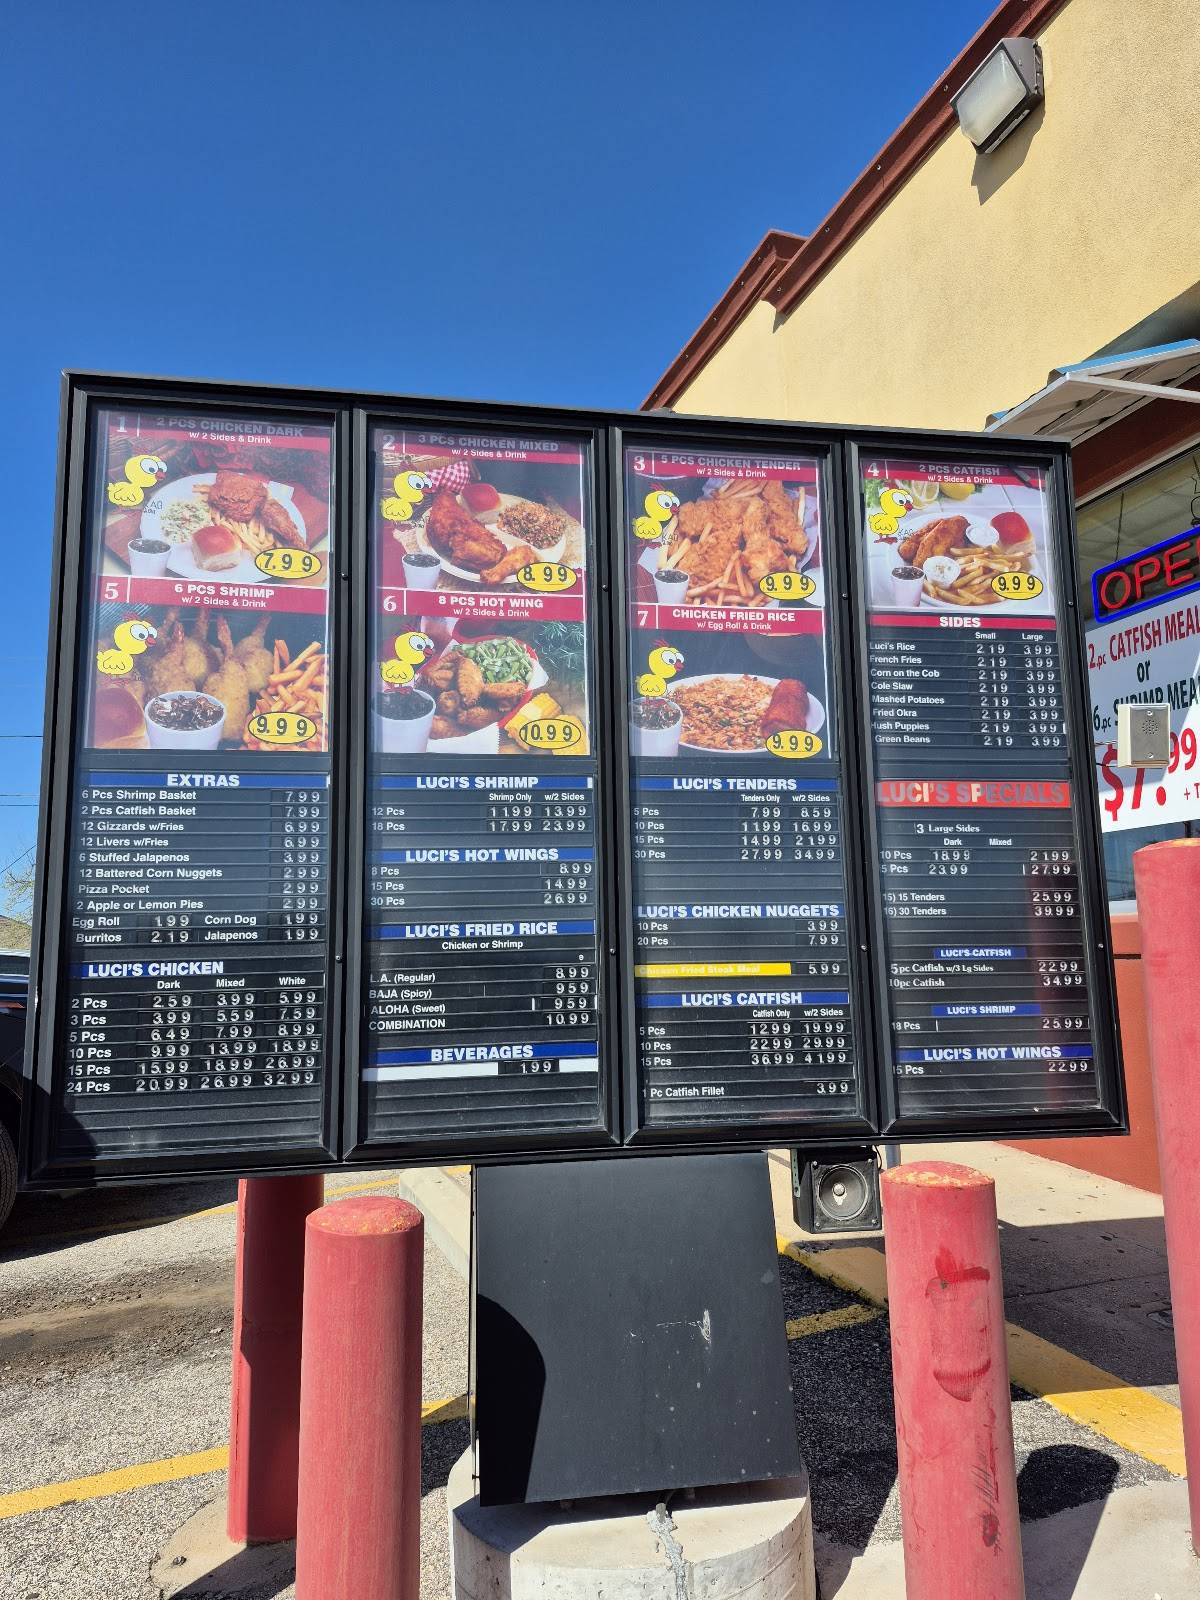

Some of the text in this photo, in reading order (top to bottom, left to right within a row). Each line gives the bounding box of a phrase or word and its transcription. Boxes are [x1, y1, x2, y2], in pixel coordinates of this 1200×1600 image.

[115, 416, 127, 433] 1
[156, 417, 304, 436] 2 PCS CHICKEN DARK
[382, 435, 396, 450] 2
[418, 435, 559, 451] 3 PCS CHICKEN MIXED
[634, 456, 645, 471] 3
[661, 456, 801, 470] 5 PCS CHICKEN TENDER
[868, 463, 880, 476] 4
[929, 465, 951, 474] PCS
[953, 466, 1000, 475] CATFISH
[1101, 536, 1200, 609] OPE
[104, 582, 119, 600] 5
[174, 584, 274, 598] 6 PCS SHRIMP
[203, 597, 229, 606] Sides
[232, 598, 239, 606] &
[242, 600, 267, 608] Drink
[383, 596, 397, 611] 6
[439, 596, 544, 608] 8 PCS HOT WING
[637, 611, 649, 626] 7
[673, 609, 795, 621] CHICKEN FRIED RICE
[708, 622, 723, 630] Egg
[940, 617, 981, 628] SIDES
[1022, 633, 1043, 641] Large
[1110, 619, 1161, 661] CATFISH
[896, 643, 915, 651] Rice
[871, 669, 891, 677] Corn
[922, 670, 940, 678] Cob
[1137, 660, 1150, 682] or
[872, 695, 945, 704] Mashed Potatoes
[1167, 676, 1200, 712] MEA
[896, 709, 917, 717] Okra
[875, 735, 901, 743] Green
[167, 774, 240, 787] EXTRAS
[416, 777, 539, 788] LUCI'S SHRIMP
[673, 778, 797, 790] LUCI'S TENDERS
[81, 790, 196, 802] 6 Pcs Shrimp Basket
[489, 793, 514, 802] Shrimp
[516, 794, 532, 802] Only
[544, 793, 559, 801] w/2
[956, 783, 1064, 803] SPECIALS
[81, 821, 184, 831] 12 Gizzards w/Fries
[916, 824, 980, 833] 3 Large Sides
[944, 838, 1012, 846] Dark Mixed
[405, 849, 559, 862] LUCI'S HOT WINGS
[80, 868, 223, 880] 12 Battered Corn Nuggets
[78, 885, 150, 894] Pizza Pocket
[638, 905, 839, 918] LUCI'S CHICKEN NUGGETS
[72, 917, 120, 929] Egg Roll
[204, 916, 257, 927] Corn Dog
[405, 922, 558, 937] LUCI'S FRIED RICE
[76, 933, 122, 943] Burritos
[204, 930, 258, 942] Jalapenos
[442, 941, 478, 950] Chicken
[492, 940, 523, 950] Shrimp
[88, 961, 224, 977] LUCI'S CHICKEN
[157, 976, 306, 989] Dark Mixed White
[369, 989, 432, 999] BAJA (Spicy)
[682, 992, 801, 1006] LUCI'S CATFISH
[371, 1004, 445, 1014] ALOHA (Sweet)
[776, 1010, 790, 1018] Only
[804, 1009, 819, 1017] w/2
[820, 1008, 843, 1016] Sides
[947, 1006, 1016, 1014] LUCI'S SHRIMP
[369, 1020, 445, 1030] COMBINATION
[431, 1046, 534, 1062] BEVERAGES
[924, 1047, 1061, 1060] LUCI'S HOT WINGS
